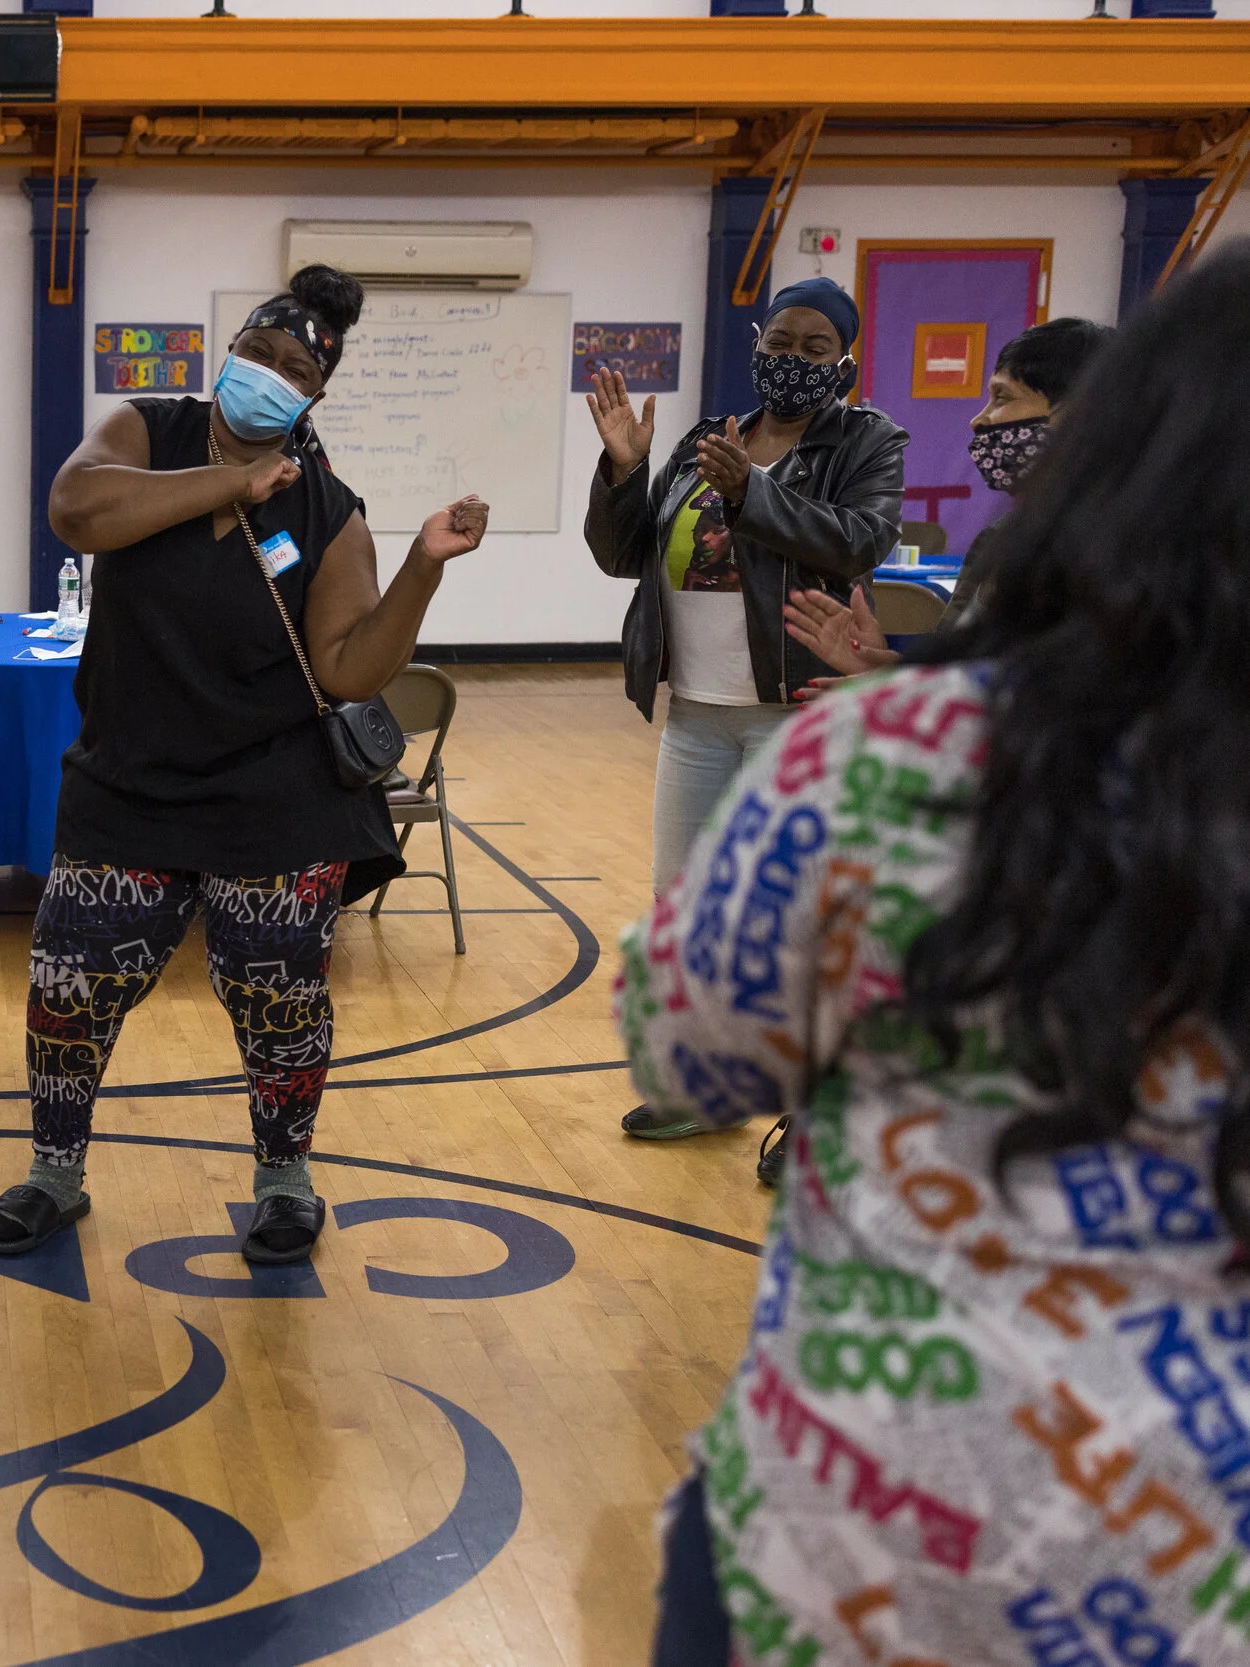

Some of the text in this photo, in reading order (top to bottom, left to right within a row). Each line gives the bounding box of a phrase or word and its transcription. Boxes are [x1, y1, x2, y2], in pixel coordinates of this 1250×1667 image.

[95, 327, 204, 354] STRONGER
[107, 356, 188, 389] TOGETHER
[731, 804, 828, 1024] QUEEN
[800, 1329, 981, 1404] GOOD
[1012, 1378, 1217, 1577] LIFE
